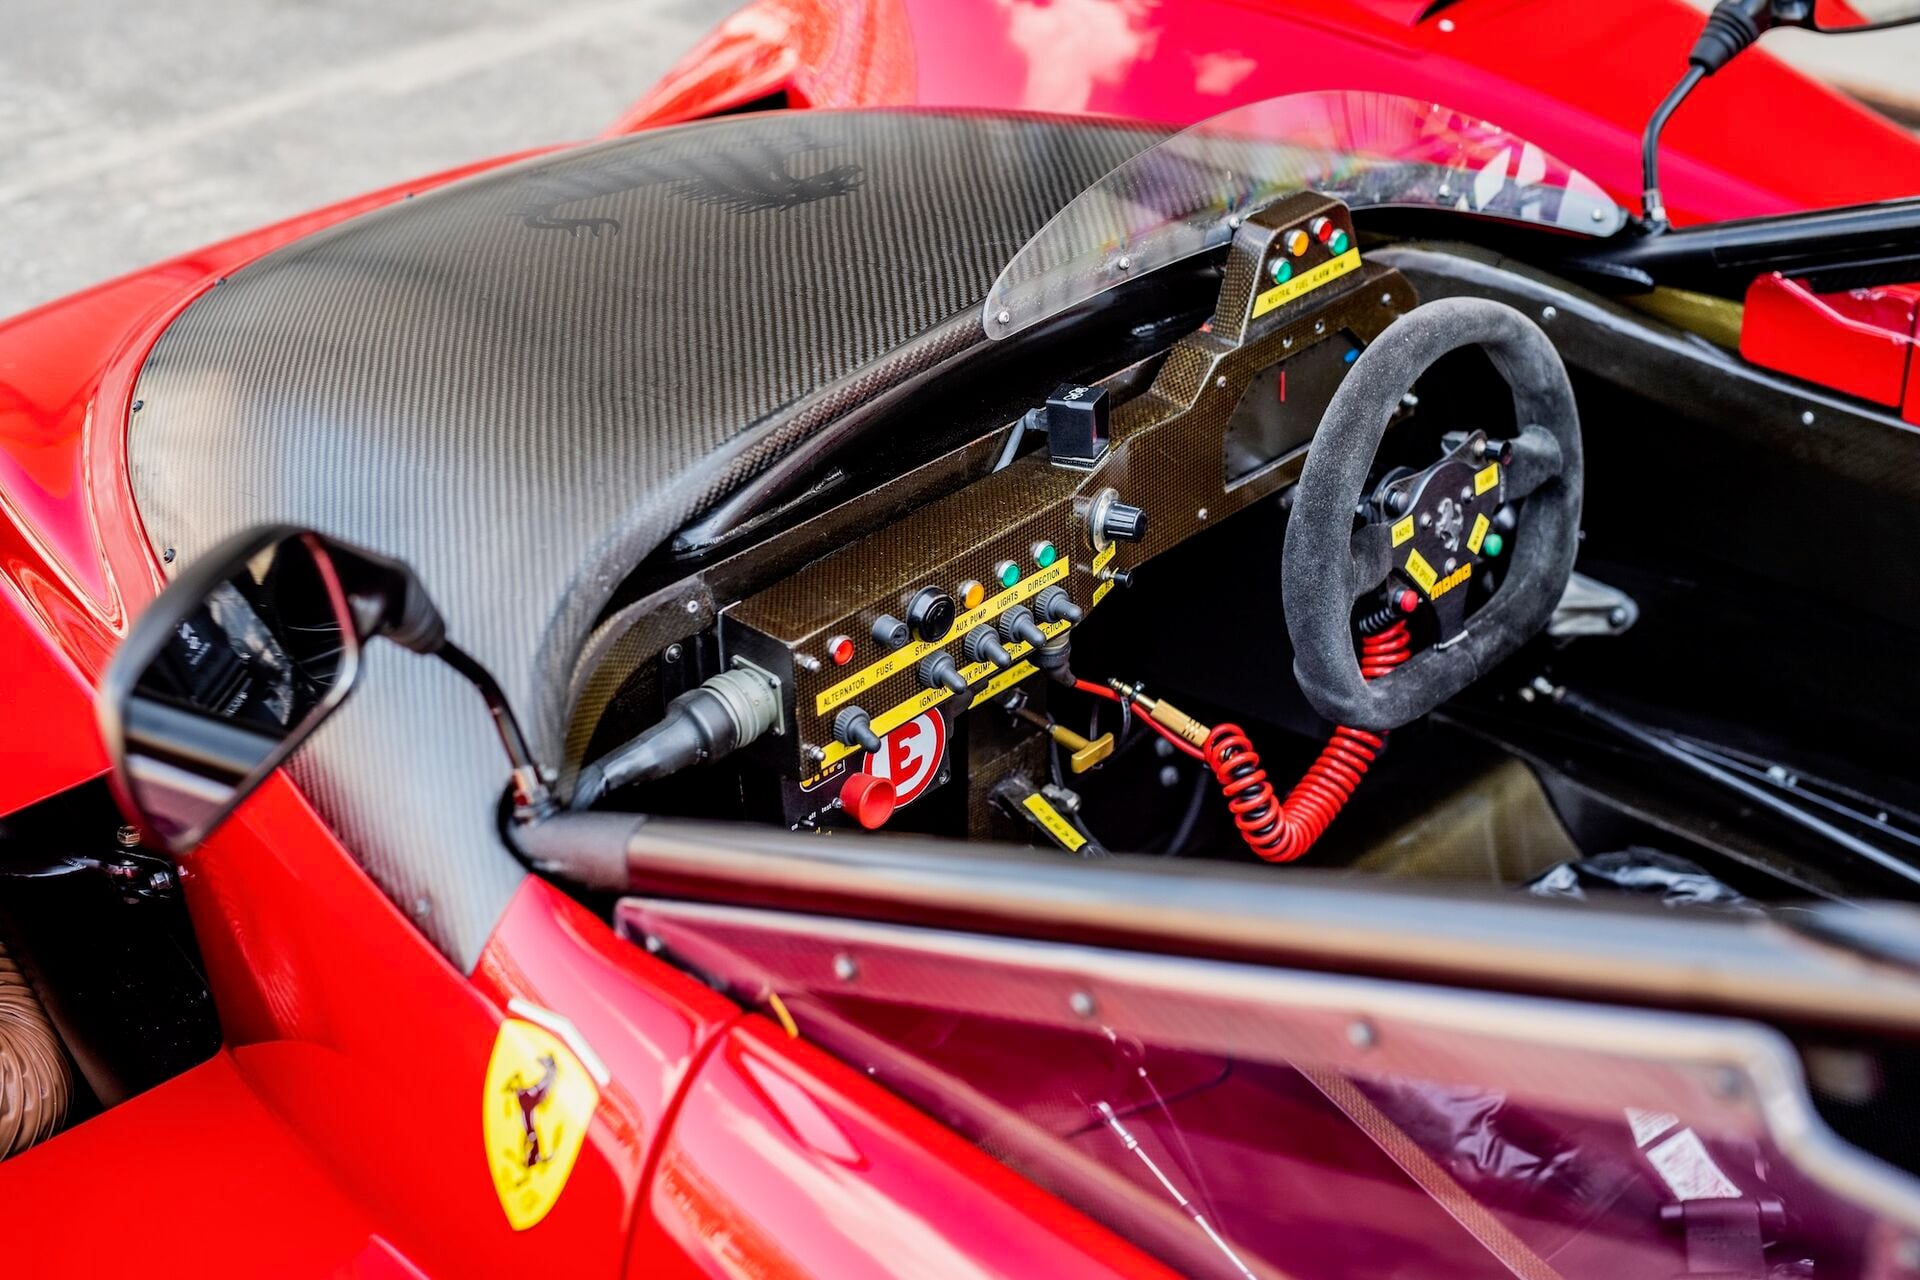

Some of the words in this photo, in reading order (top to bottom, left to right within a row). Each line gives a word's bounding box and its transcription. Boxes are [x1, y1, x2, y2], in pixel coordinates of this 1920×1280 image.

[823, 677, 866, 707] ALTERNATOR
[876, 660, 894, 678] FUSE
[955, 620, 969, 633] AUX
[970, 608, 987, 625] PUMP
[996, 590, 1019, 610] LIGHTS
[1027, 567, 1061, 593] DIRECTION
[919, 686, 949, 708] IGNITION
[887, 721, 923, 787] E
[808, 811, 817, 821] off
[821, 803, 832, 814] test
